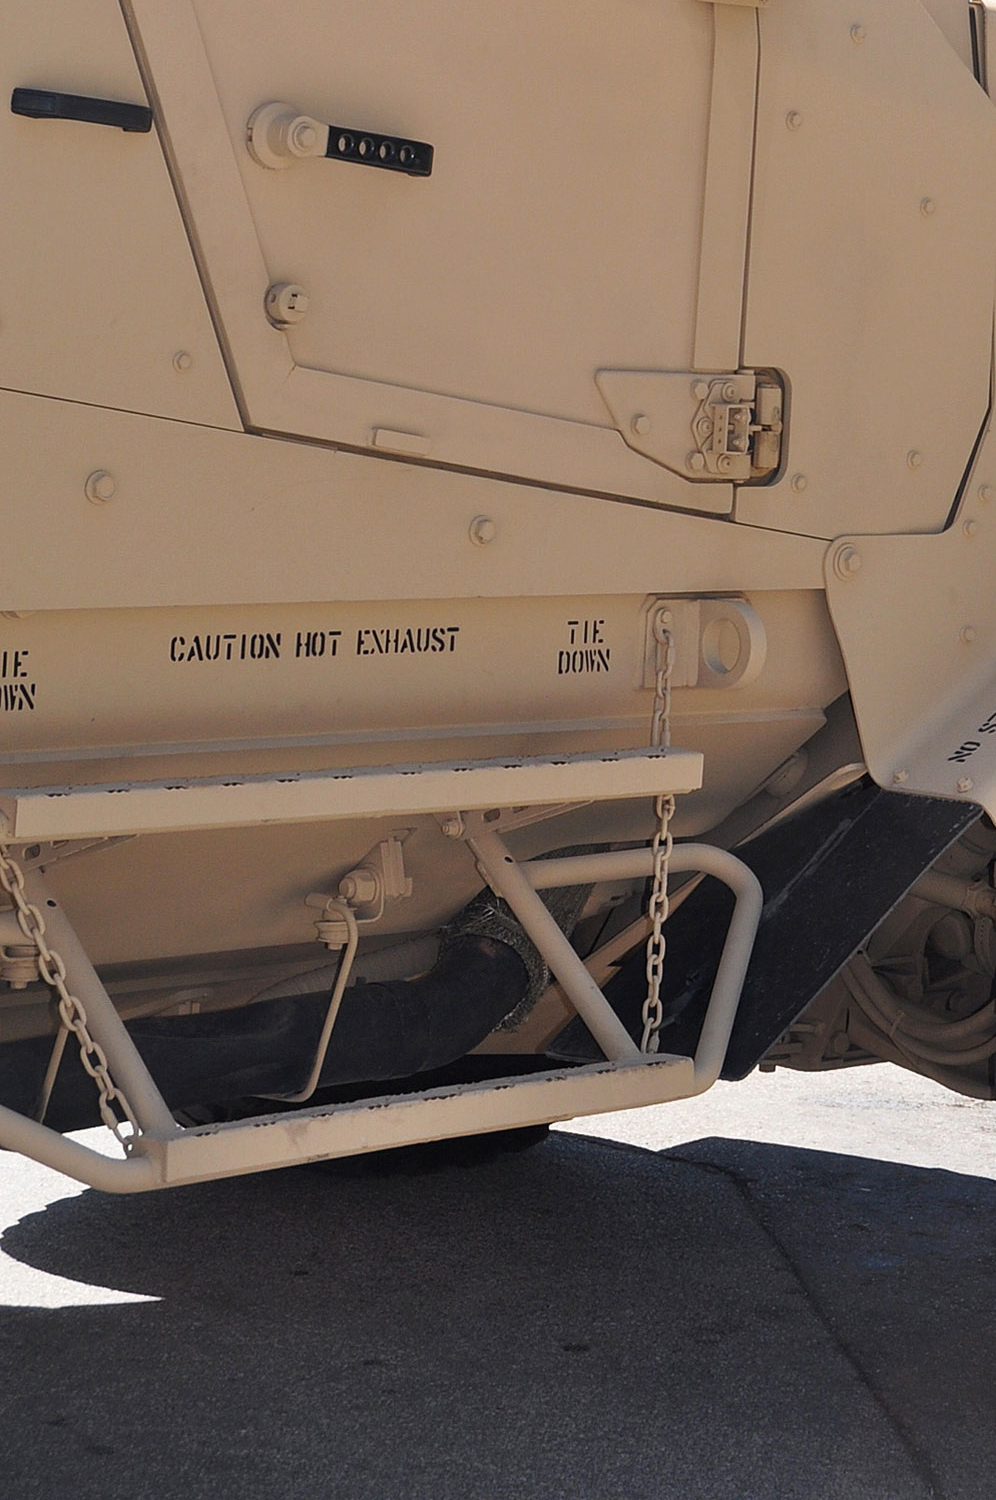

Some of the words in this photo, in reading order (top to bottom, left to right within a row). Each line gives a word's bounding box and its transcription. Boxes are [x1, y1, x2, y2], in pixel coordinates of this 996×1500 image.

[170, 633, 281, 661] CAUTION
[295, 631, 342, 658] HOT
[356, 627, 459, 655] EXHAUST
[567, 620, 605, 645] TIE
[2, 651, 29, 678] IE
[558, 648, 610, 675] DOWN
[0, 682, 36, 712] WN
[947, 741, 981, 763] NO
